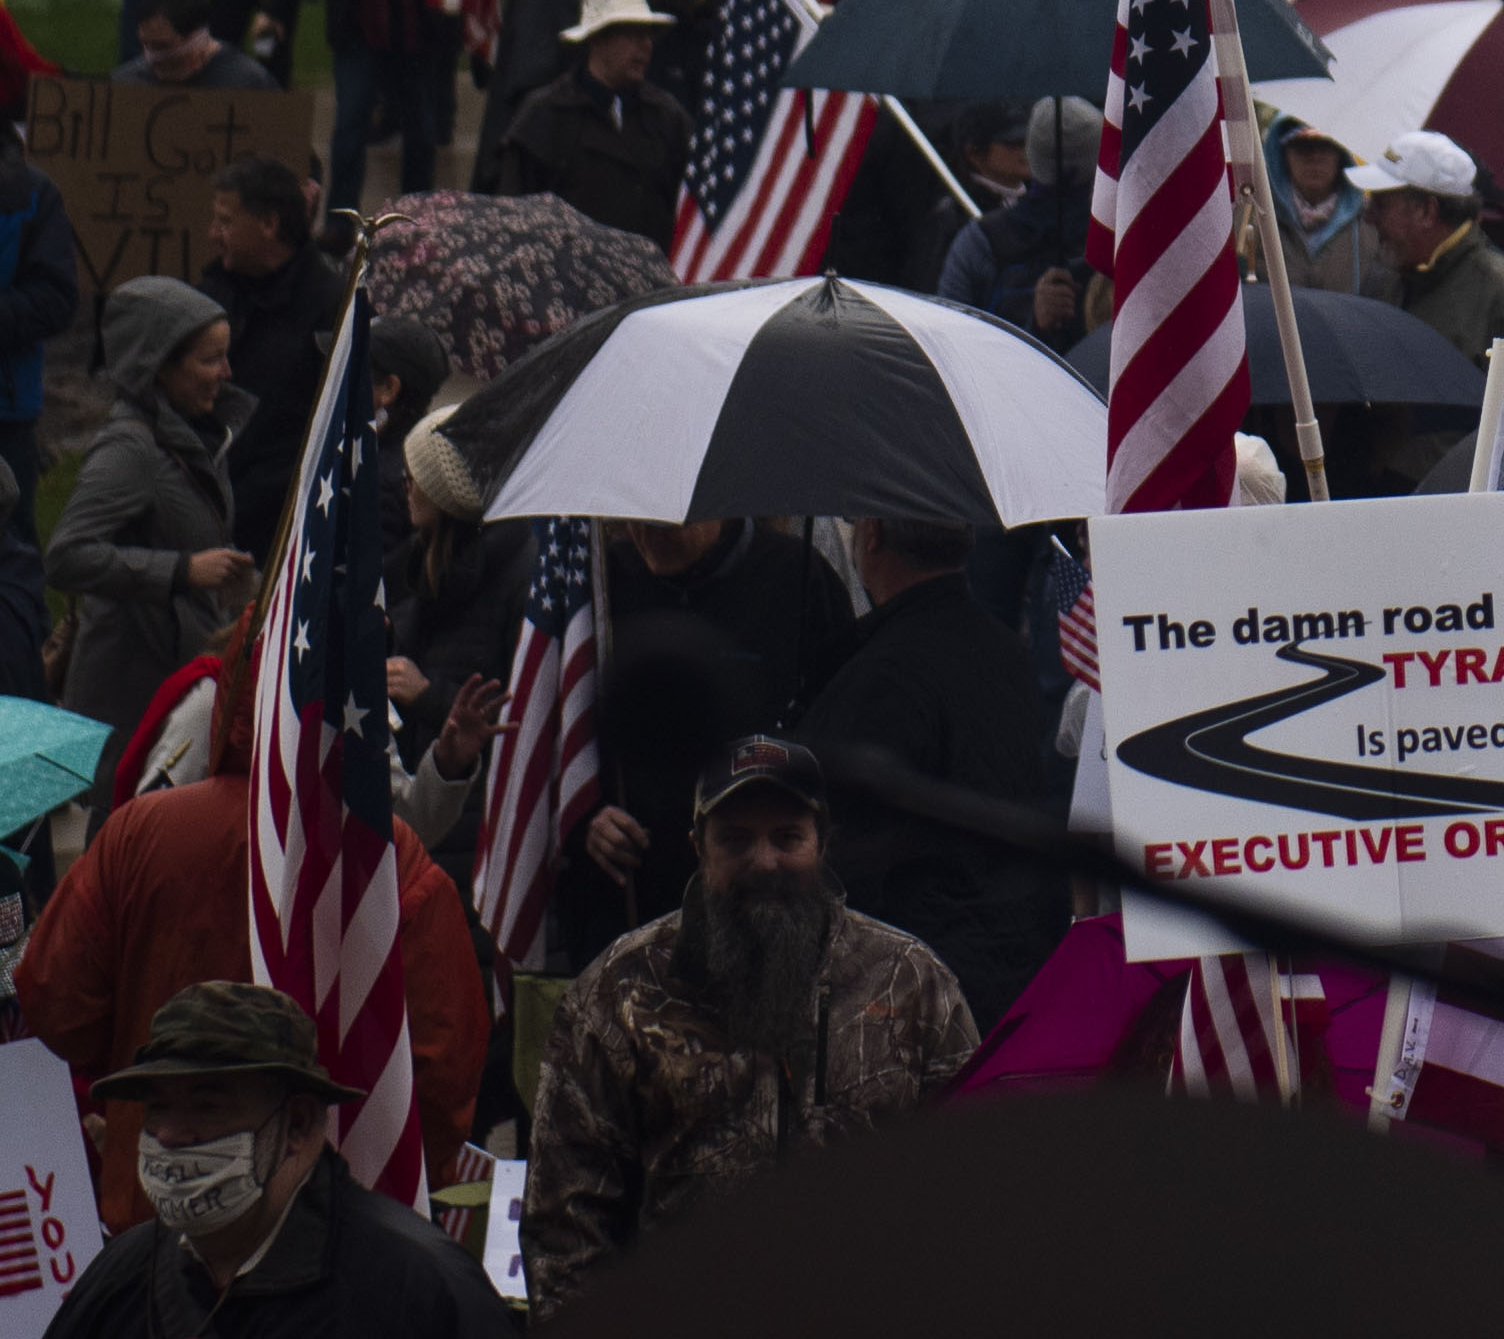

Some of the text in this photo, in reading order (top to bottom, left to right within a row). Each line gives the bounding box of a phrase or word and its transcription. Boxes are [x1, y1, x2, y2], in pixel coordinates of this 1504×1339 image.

[145, 93, 254, 175] Gat
[91, 173, 174, 222] IS
[1123, 613, 1216, 651] The
[1233, 608, 1366, 644] damn
[1383, 593, 1494, 635] road
[1357, 724, 1385, 757] Is
[1143, 825, 1427, 881] EXECUTIVE
